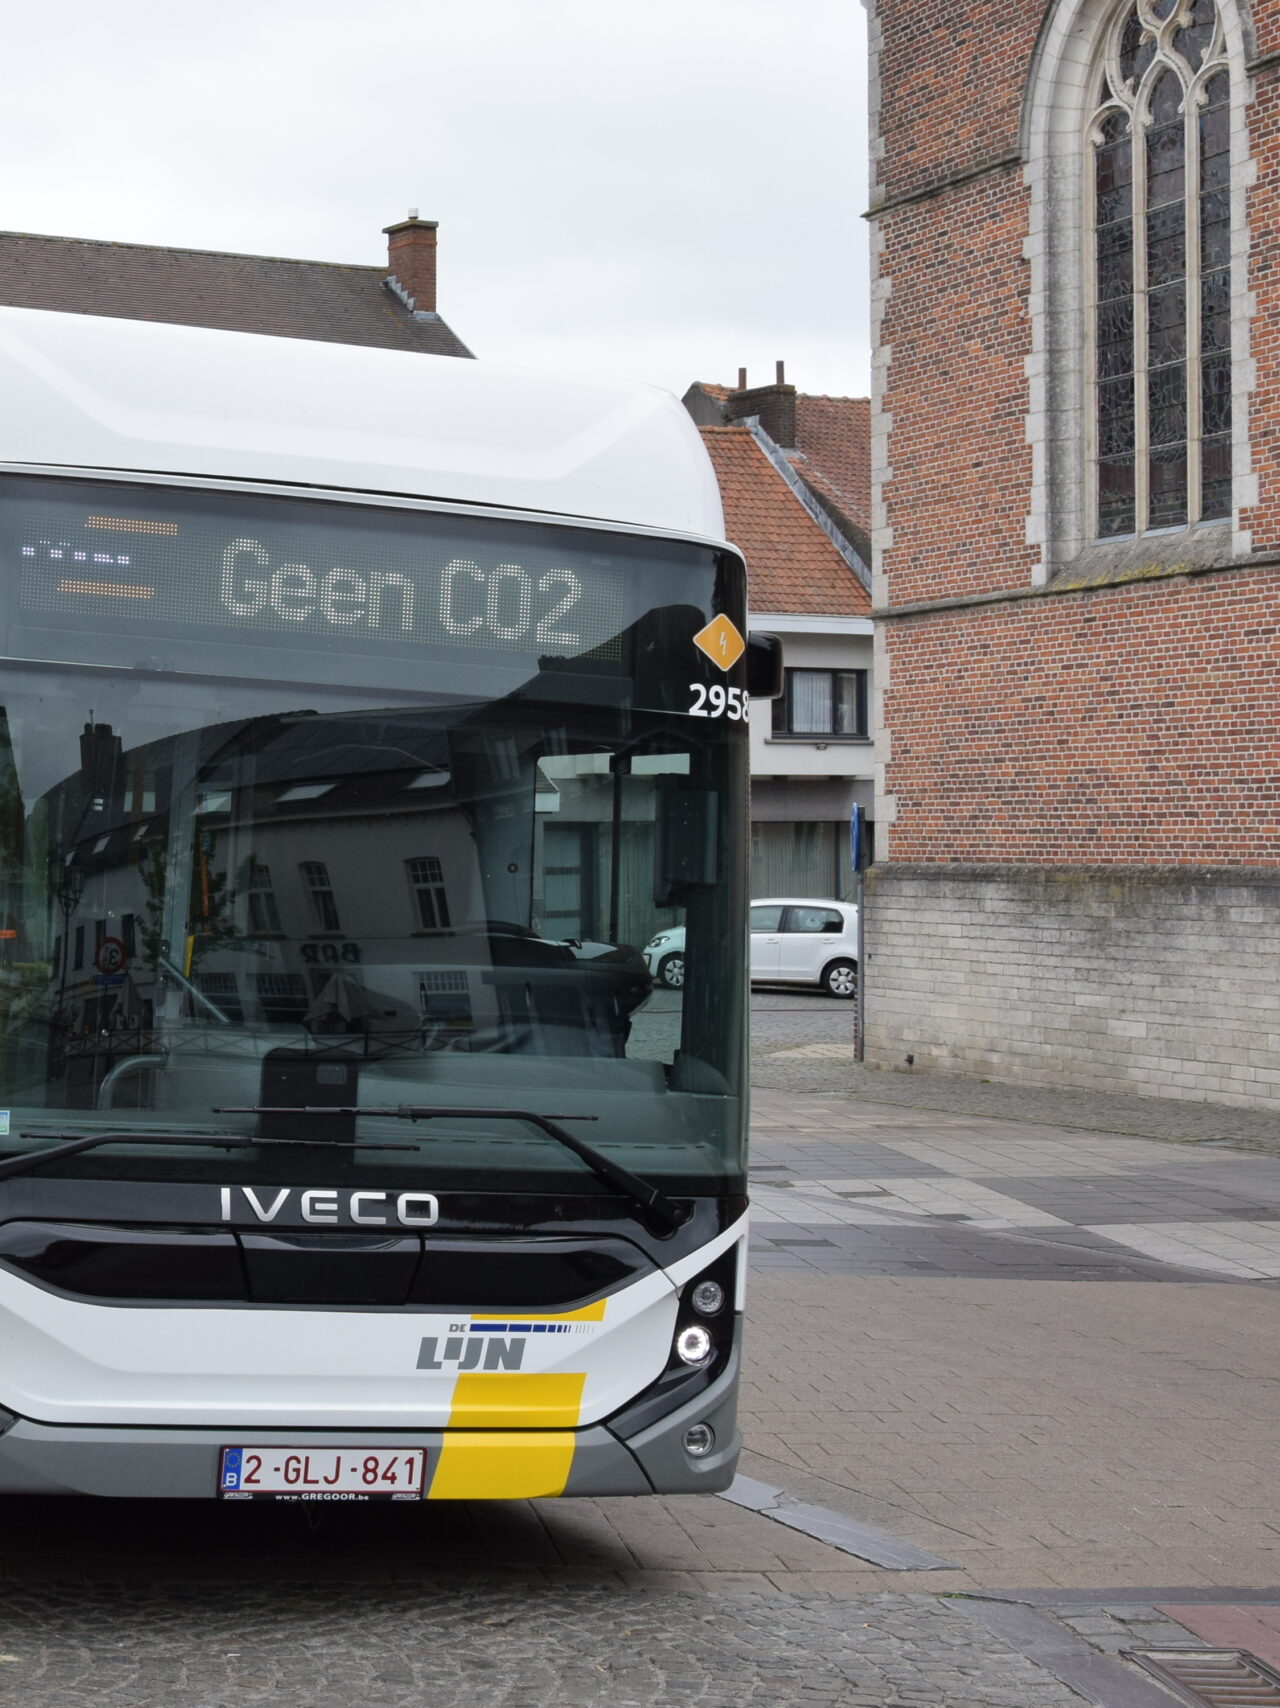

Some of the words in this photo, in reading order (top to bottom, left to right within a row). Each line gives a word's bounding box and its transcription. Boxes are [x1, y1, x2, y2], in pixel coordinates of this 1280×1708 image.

[220, 538, 415, 630] Geen
[689, 683, 749, 723] 2958
[221, 1187, 438, 1226] IVECO
[449, 1323, 466, 1333] DE
[415, 1337, 527, 1370] LIJN
[225, 1472, 237, 1486] B
[275, 1493, 369, 1501] www.GREGOOR.be
